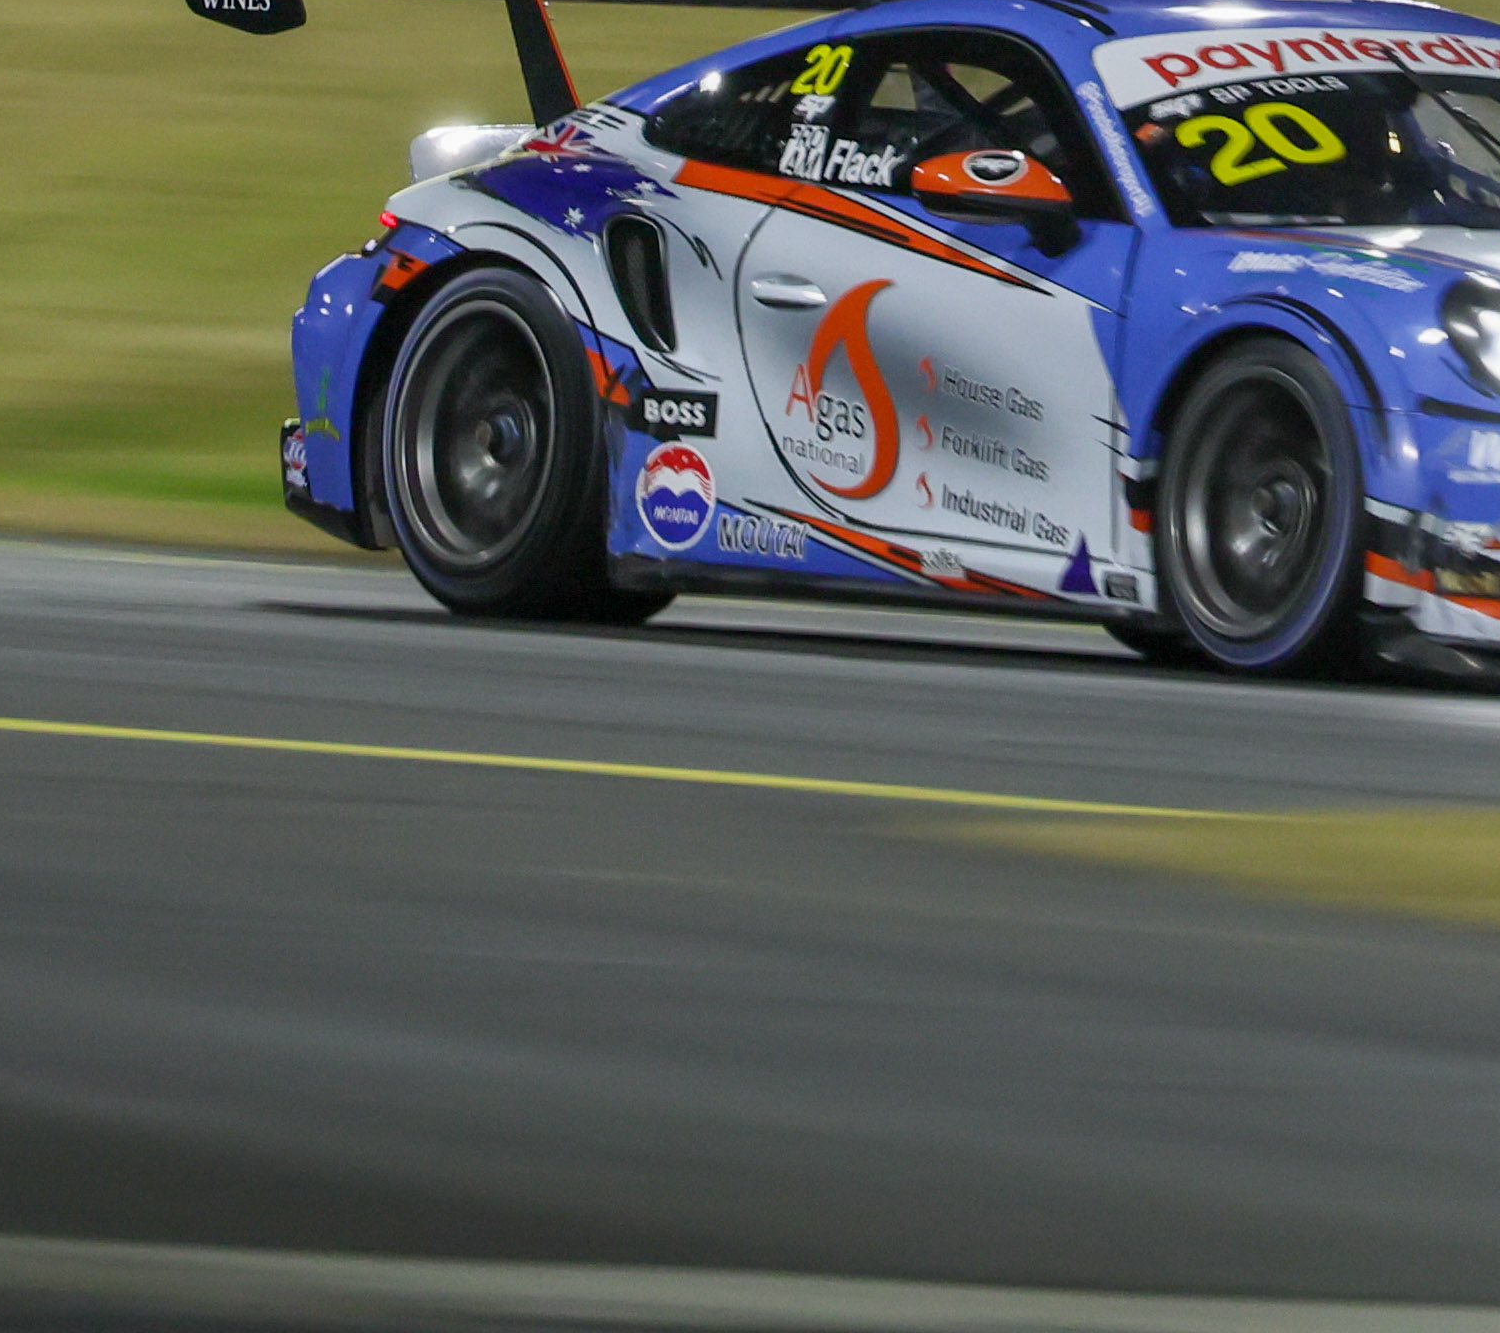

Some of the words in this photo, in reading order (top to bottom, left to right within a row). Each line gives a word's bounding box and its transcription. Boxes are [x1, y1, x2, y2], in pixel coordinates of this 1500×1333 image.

[790, 44, 854, 94] 20
[1251, 75, 1349, 97] TOOLS
[824, 138, 907, 187] Flack
[1175, 101, 1346, 187] 20
[643, 398, 706, 427] BOSS
[942, 365, 1003, 409] House
[1005, 387, 1045, 421] Gas
[782, 435, 866, 475] national
[941, 424, 1009, 469] Forklift
[1011, 448, 1050, 482] Gas
[942, 483, 1030, 532] Industrial
[1032, 513, 1071, 546] Gas
